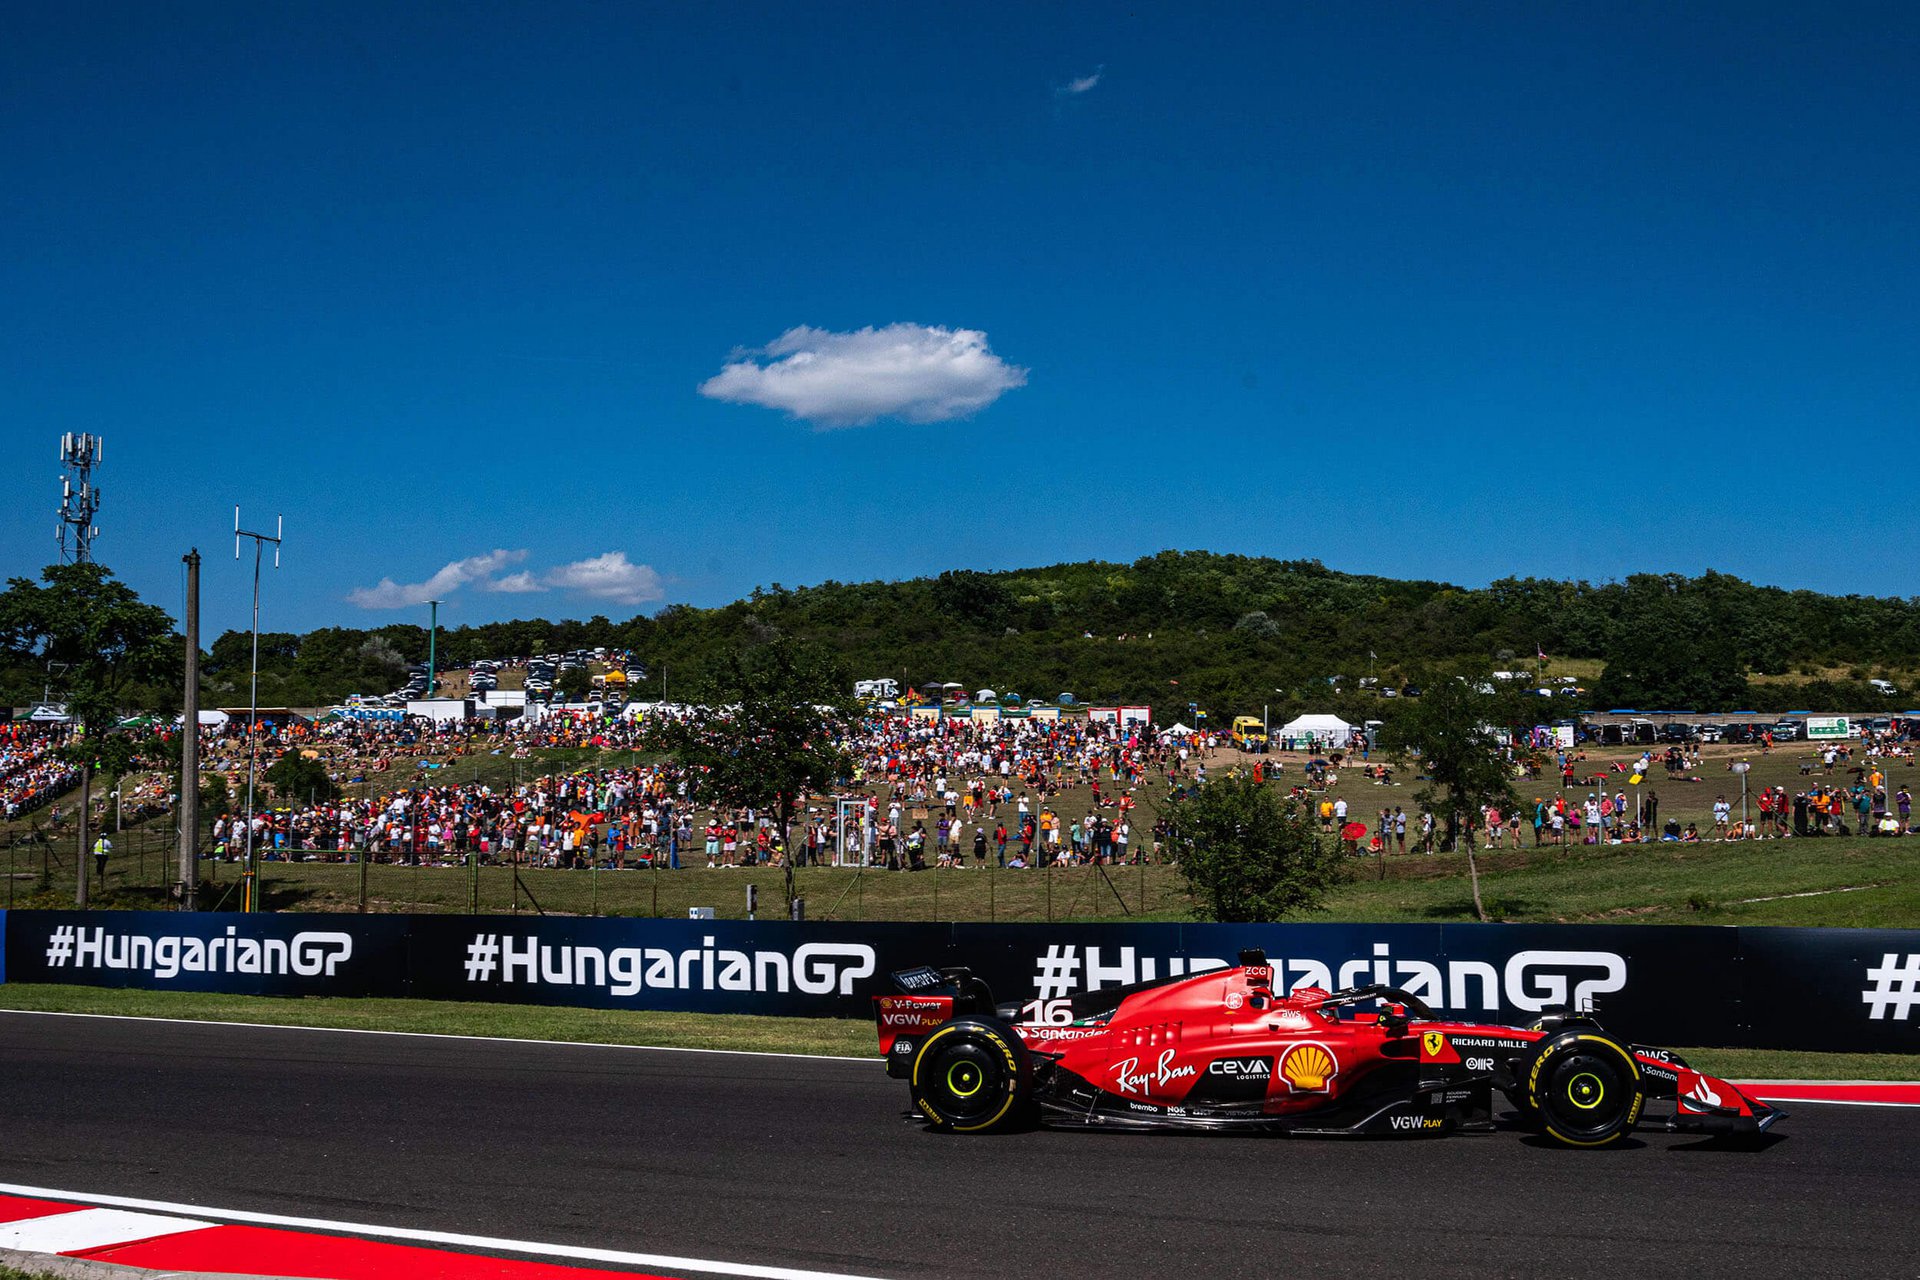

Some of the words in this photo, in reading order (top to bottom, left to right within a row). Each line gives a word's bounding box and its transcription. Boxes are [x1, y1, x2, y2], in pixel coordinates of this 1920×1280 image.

[46, 926, 352, 978] #HungarianGP
[464, 934, 876, 996] #HungarianGP
[1033, 944, 1627, 1013] #HarianGP
[894, 1000, 942, 1009] V-Power
[883, 1014, 921, 1026] VGW
[921, 1018, 943, 1026] PLAY
[1022, 1000, 1074, 1027] 16
[1030, 1028, 1110, 1040] Santander
[896, 1042, 911, 1053] FIA
[1452, 1037, 1495, 1048] RICHARD
[1498, 1040, 1528, 1049] MILLE
[985, 1031, 1017, 1072] ZERO
[1529, 1045, 1554, 1093] ZERO
[1130, 1102, 1158, 1113] brembo
[1390, 1115, 1424, 1129] VGW
[1424, 1118, 1443, 1128] PLAY
